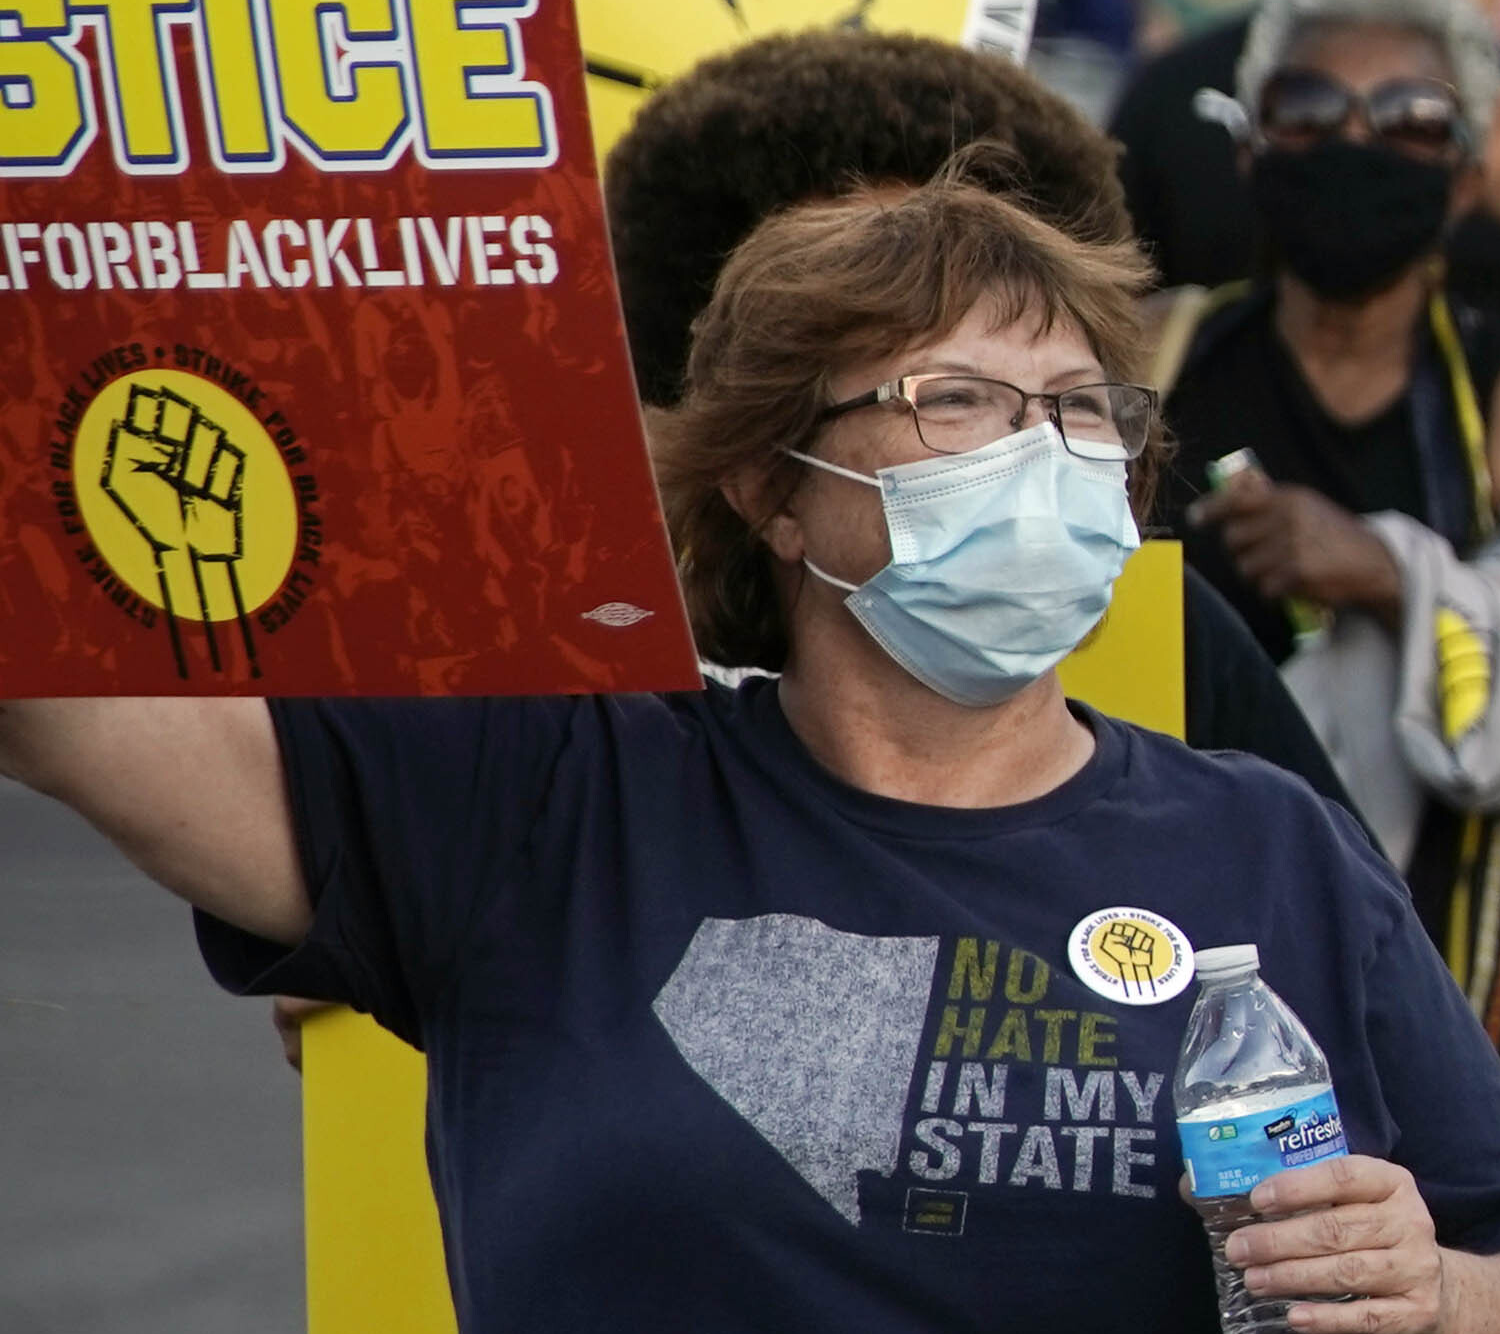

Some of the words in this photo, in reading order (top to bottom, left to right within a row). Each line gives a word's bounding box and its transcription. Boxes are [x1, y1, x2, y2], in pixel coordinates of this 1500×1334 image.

[0, 214, 560, 290] FORBLACKLIVES
[948, 936, 1050, 1004] NO
[934, 1006, 1119, 1067] HATE
[921, 1060, 1009, 1118] IN
[1043, 1067, 1166, 1123] MY
[908, 1118, 1157, 1199] STATE
